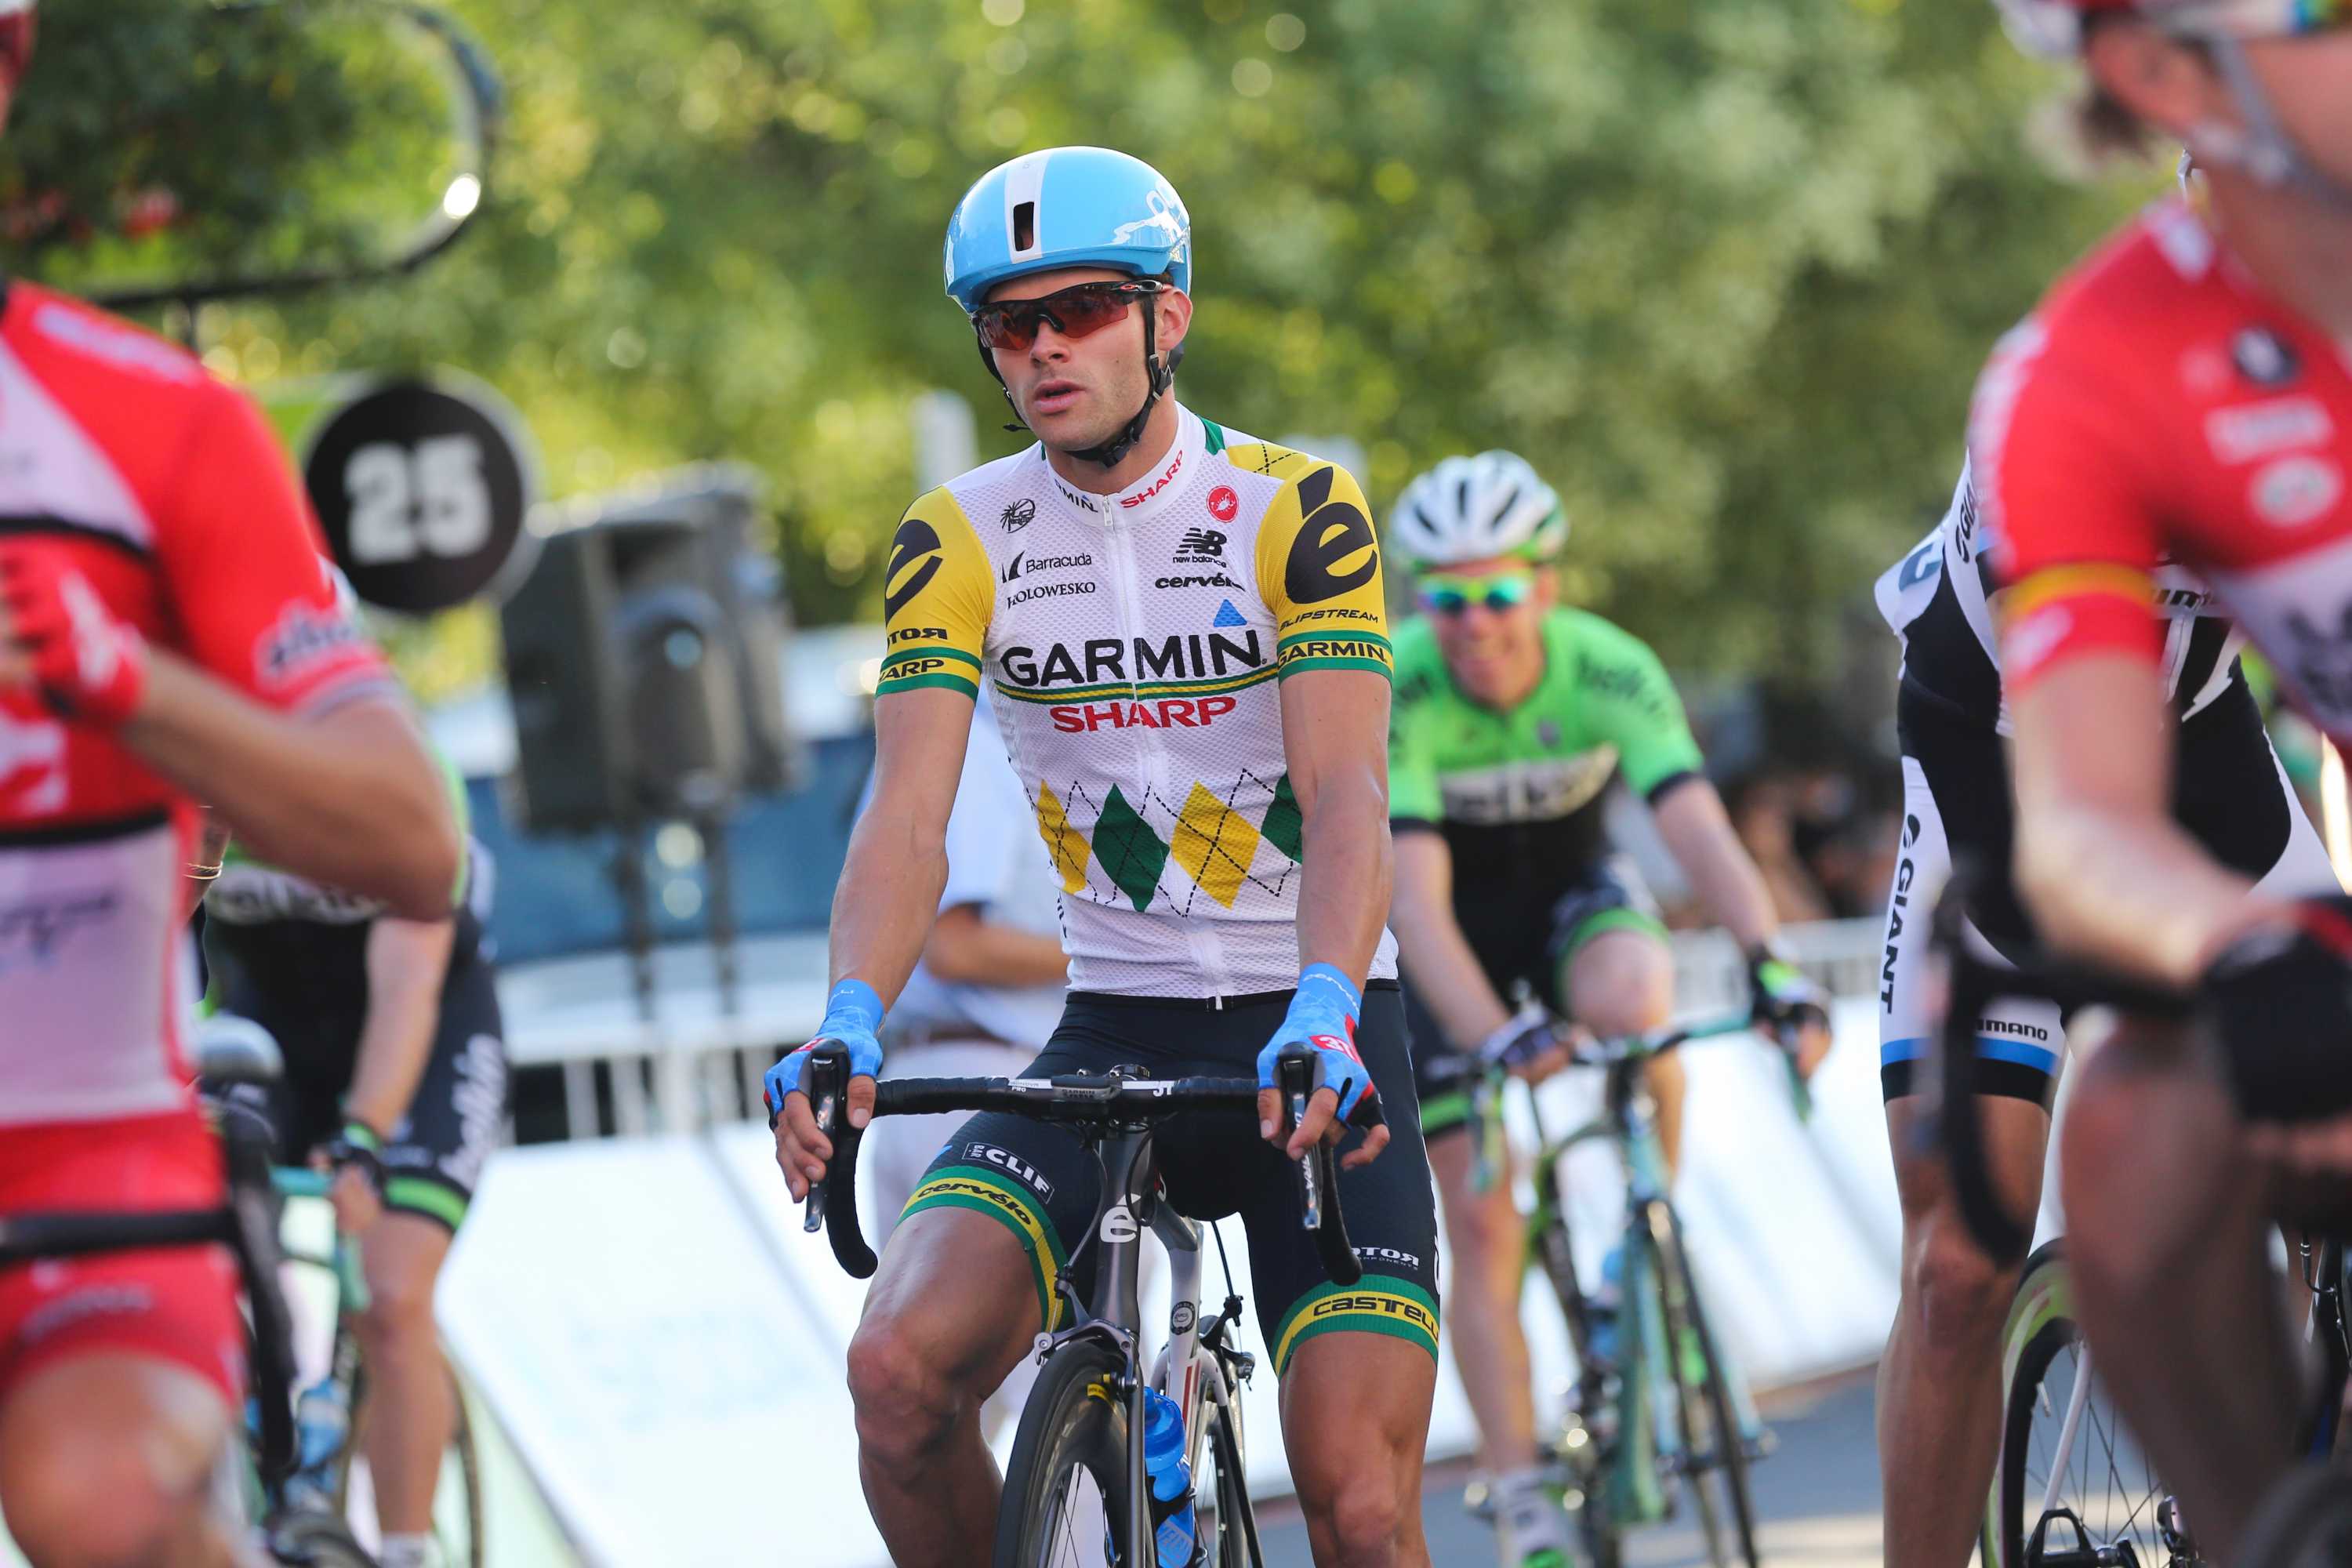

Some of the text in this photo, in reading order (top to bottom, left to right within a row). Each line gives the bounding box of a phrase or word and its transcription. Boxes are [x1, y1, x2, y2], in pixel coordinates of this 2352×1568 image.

[1120, 450, 1183, 508] SHARP
[343, 434, 492, 566] 25
[1026, 553, 1092, 573] Barracuda
[1192, 555, 1227, 568] balance
[1007, 582, 1096, 609] HOLOWESKO
[1155, 572, 1246, 592] cervél
[879, 659, 944, 682] ARP
[1000, 630, 1262, 687] GARMIN
[1277, 641, 1387, 670] GARMIN
[1050, 696, 1236, 733] SHARP
[1882, 858, 1915, 1014] GIANT
[970, 1145, 985, 1158] BAR
[985, 1149, 1050, 1194] CLIF
[917, 1182, 1032, 1225] cervélo
